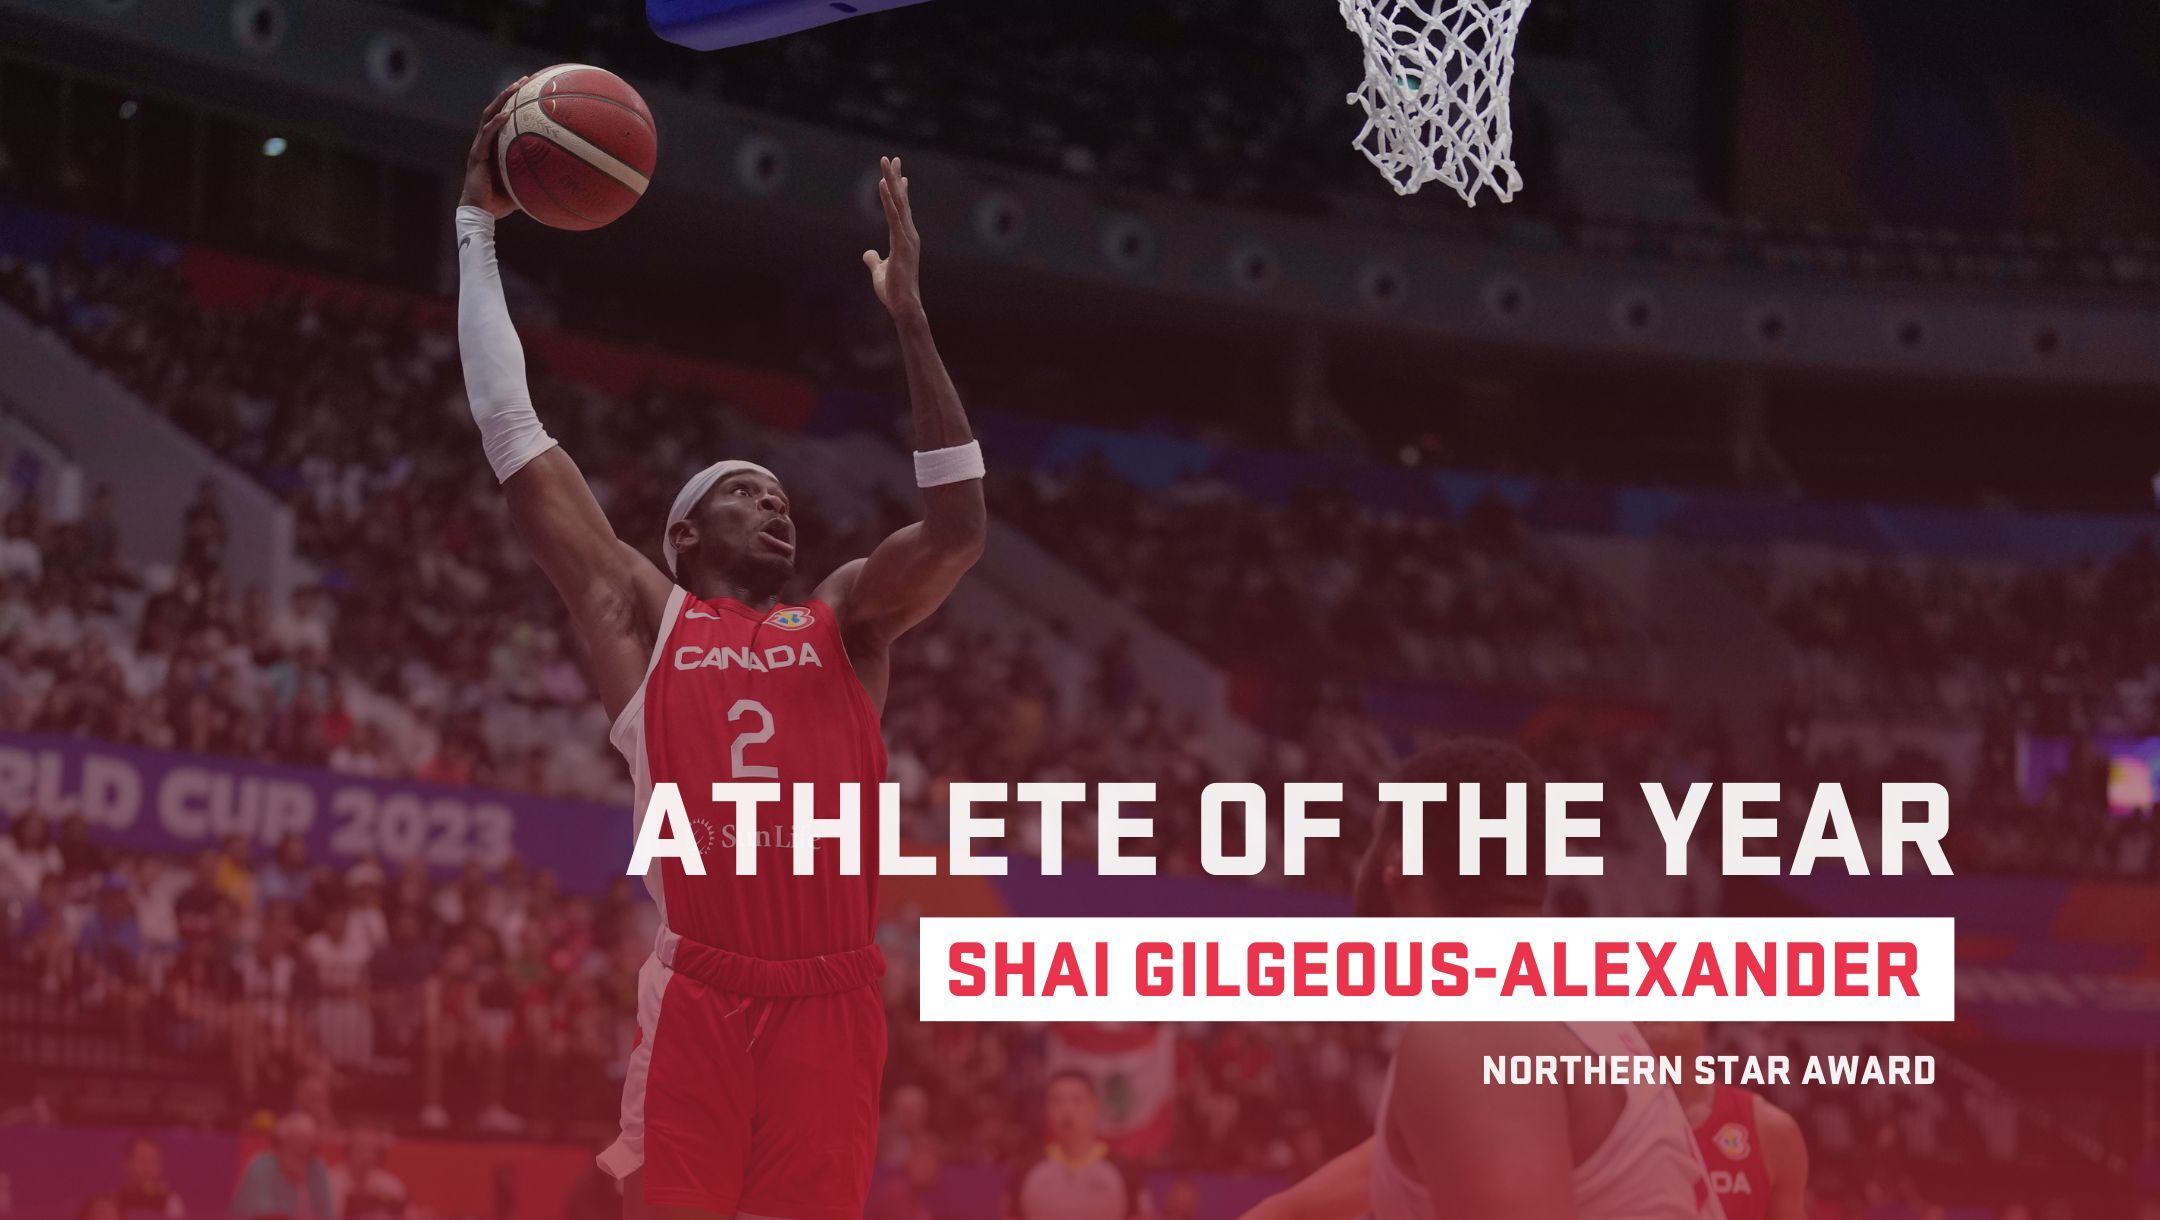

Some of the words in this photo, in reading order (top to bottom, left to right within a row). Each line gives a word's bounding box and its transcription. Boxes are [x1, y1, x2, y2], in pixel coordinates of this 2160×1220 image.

[674, 642, 822, 672] CANADA
[728, 699, 778, 778] 2
[158, 764, 317, 846] CUP
[330, 786, 515, 872] 2023
[721, 823, 771, 849] Sn
